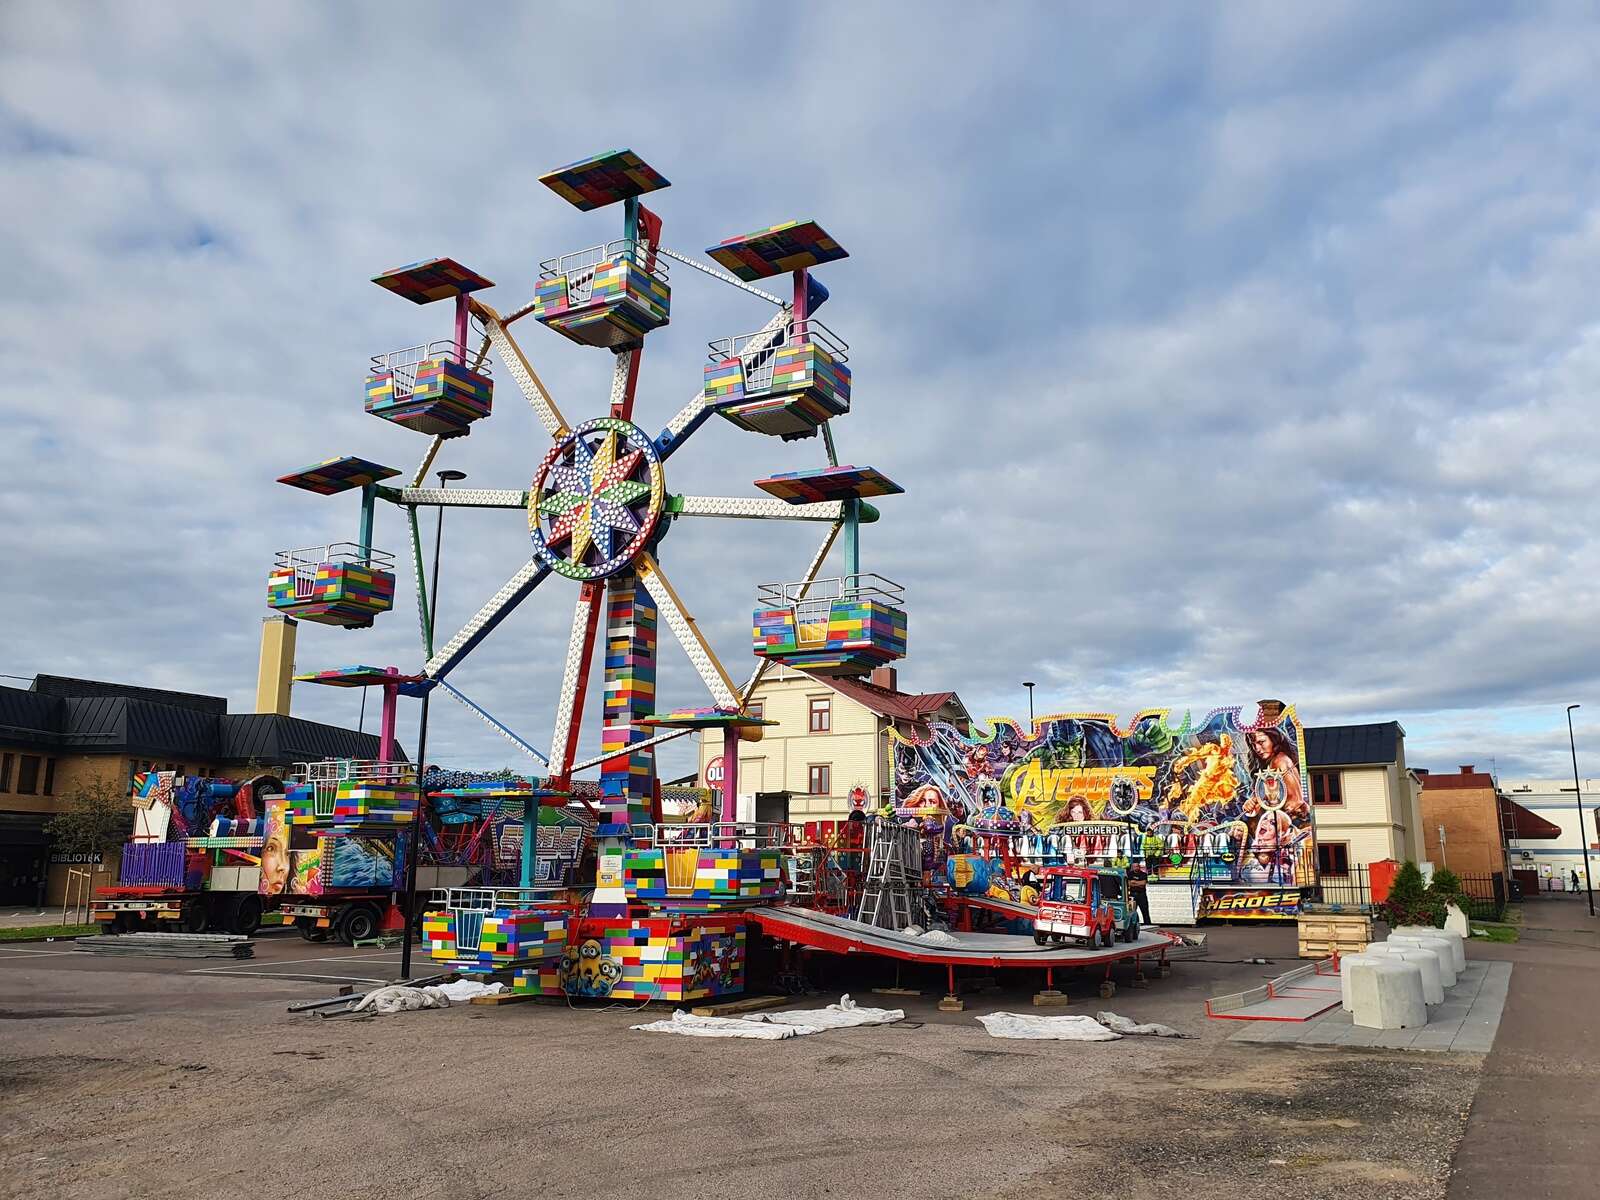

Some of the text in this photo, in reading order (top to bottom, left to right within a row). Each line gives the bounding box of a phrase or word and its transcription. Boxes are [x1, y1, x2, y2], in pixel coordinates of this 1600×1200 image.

[708, 767, 725, 781] OL
[1065, 826, 1118, 834] SUPERHERO
[51, 853, 101, 862] BIBLIOTEK
[1206, 893, 1300, 910] HEROES
